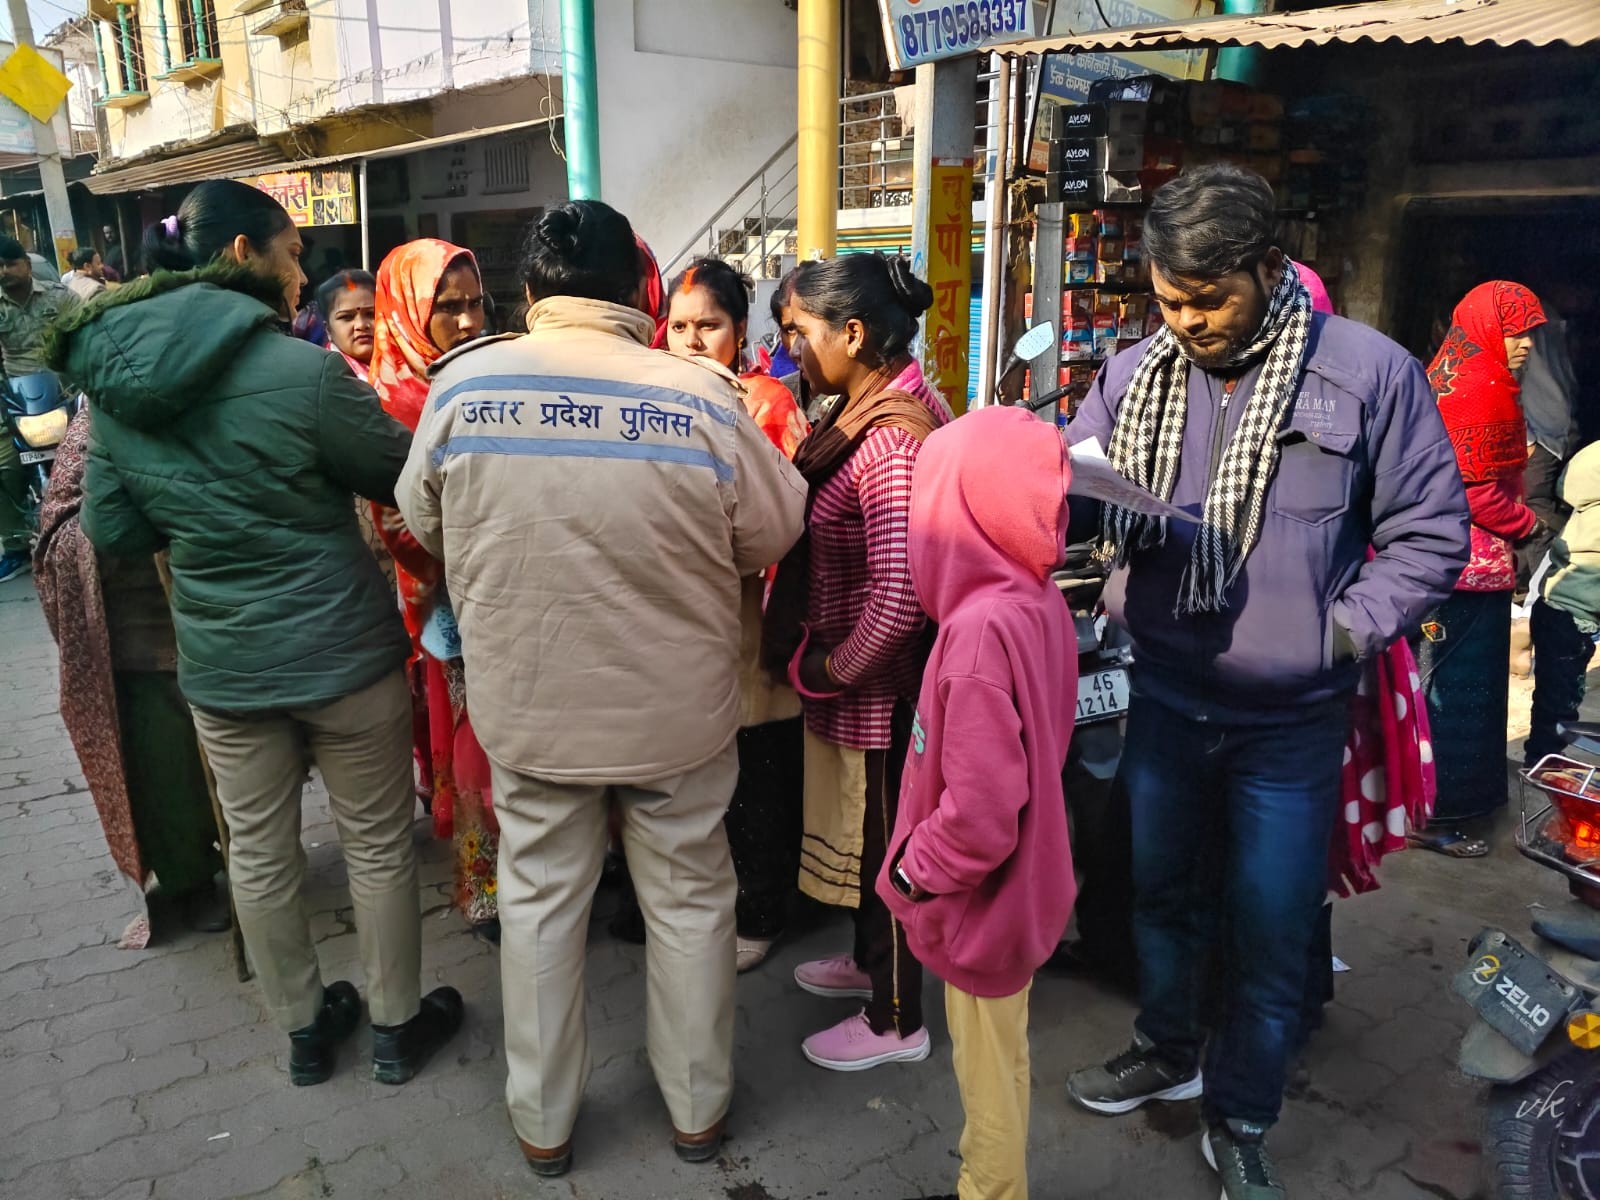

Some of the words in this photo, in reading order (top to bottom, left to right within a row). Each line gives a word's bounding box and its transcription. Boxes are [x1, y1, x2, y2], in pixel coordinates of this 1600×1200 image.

[901, 0, 1026, 57] 8779583337
[462, 400, 525, 425] उत्तर
[540, 395, 603, 429] प्रदेश
[620, 401, 693, 441] पुलिस
[1312, 398, 1336, 412] MAN
[1092, 673, 1114, 692] 46
[1077, 692, 1118, 716] 1214
[1495, 975, 1551, 1027] ZELIO
